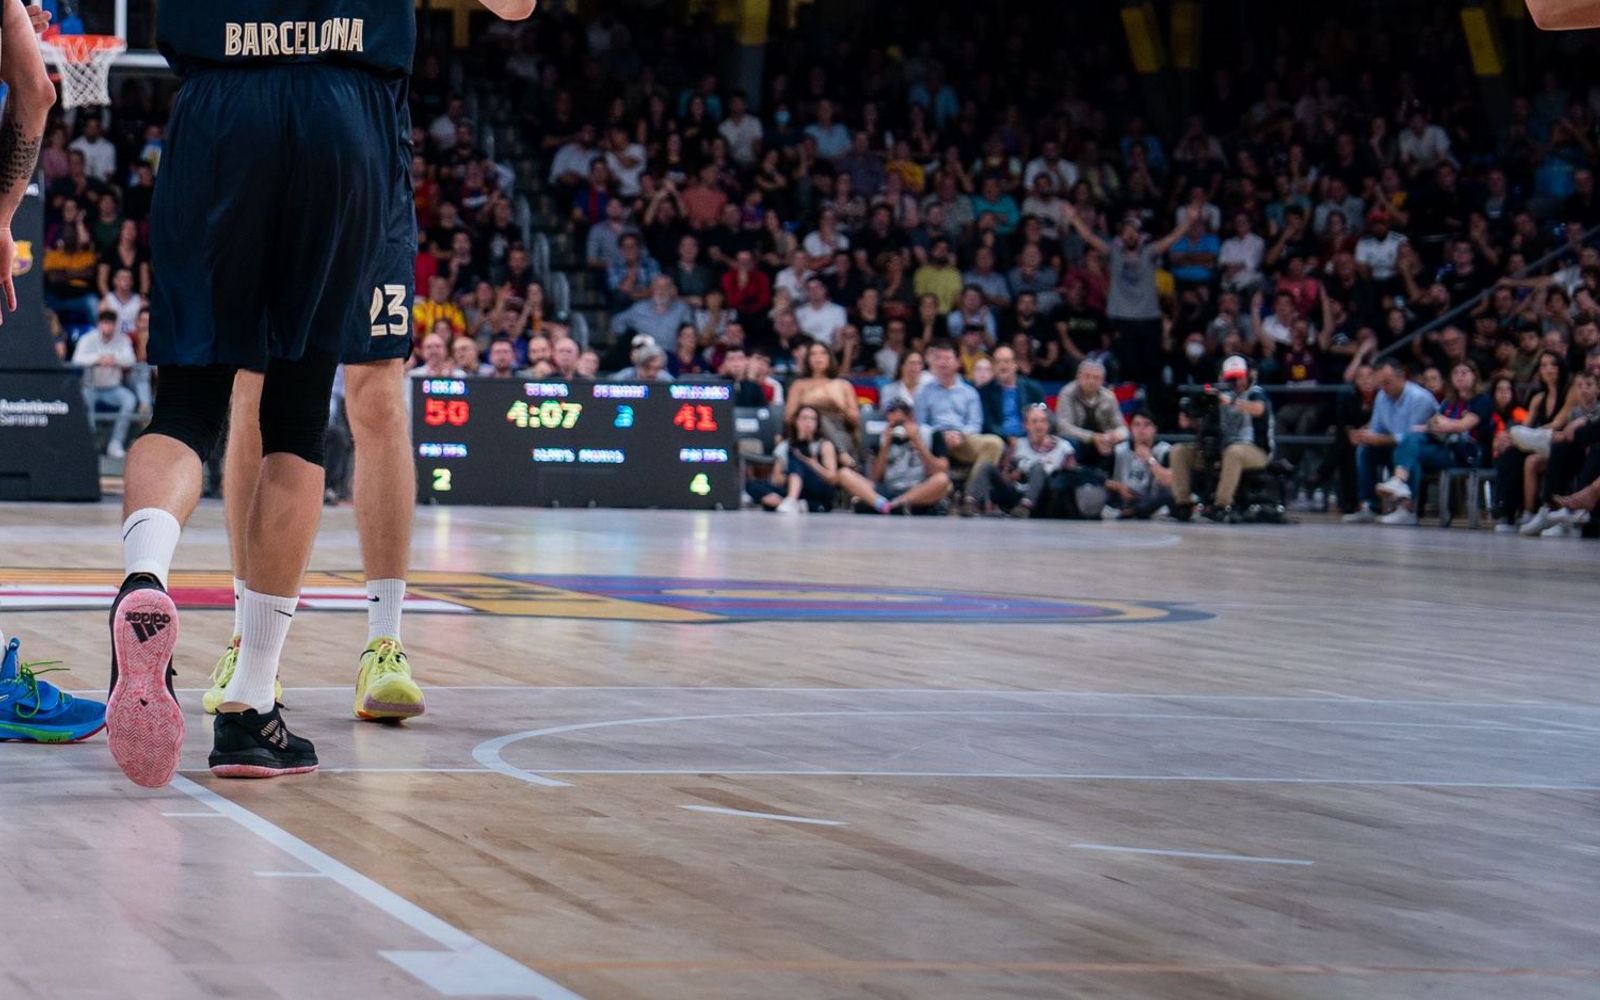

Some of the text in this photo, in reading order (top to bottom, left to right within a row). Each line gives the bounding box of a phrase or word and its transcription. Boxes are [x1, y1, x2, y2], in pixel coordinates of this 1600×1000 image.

[225, 17, 364, 56] BARCELONA
[424, 398, 470, 427] 50
[506, 399, 583, 429] 4:07
[673, 403, 718, 432] 41
[431, 467, 452, 492] 2
[689, 472, 712, 496] 4
